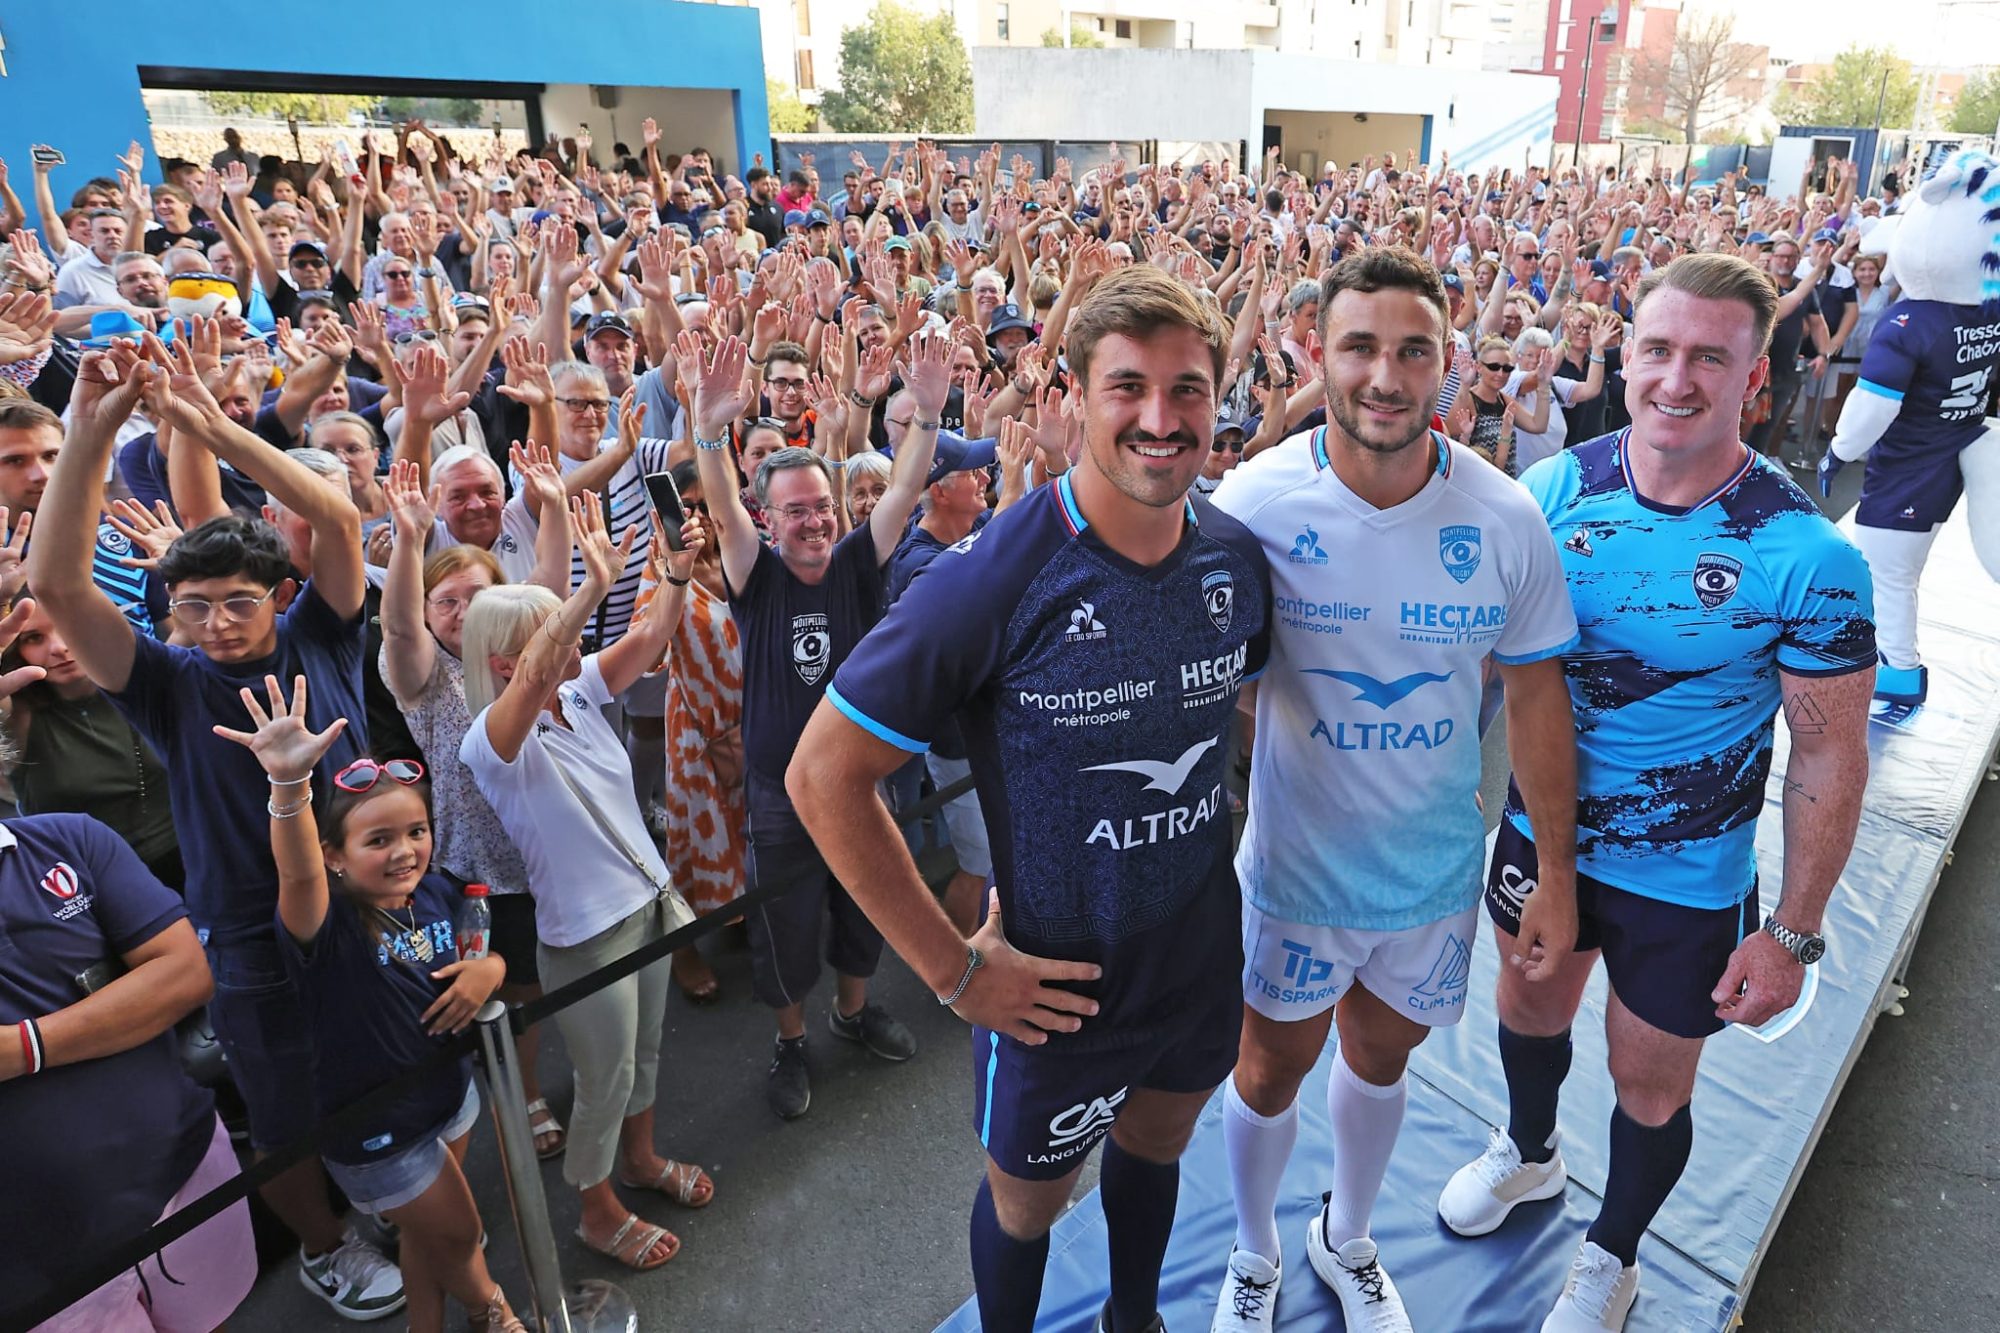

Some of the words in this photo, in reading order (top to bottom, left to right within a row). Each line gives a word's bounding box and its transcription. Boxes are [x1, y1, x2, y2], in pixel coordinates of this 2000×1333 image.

[1440, 527, 1480, 539] MONTPELLIER
[1451, 567, 1471, 578] RUGBY
[1275, 597, 1371, 621] ontpellier
[1700, 592, 1721, 605] RUGBY
[801, 664, 820, 677] RUGBY
[1020, 680, 1156, 711] Montpellier
[1310, 718, 1454, 750] ALTRAD
[1085, 782, 1221, 850] ALTRAD
[53, 900, 85, 919] WORLD
[1253, 971, 1341, 1004] TISSPARK
[1027, 1126, 1109, 1164] LANGUED
